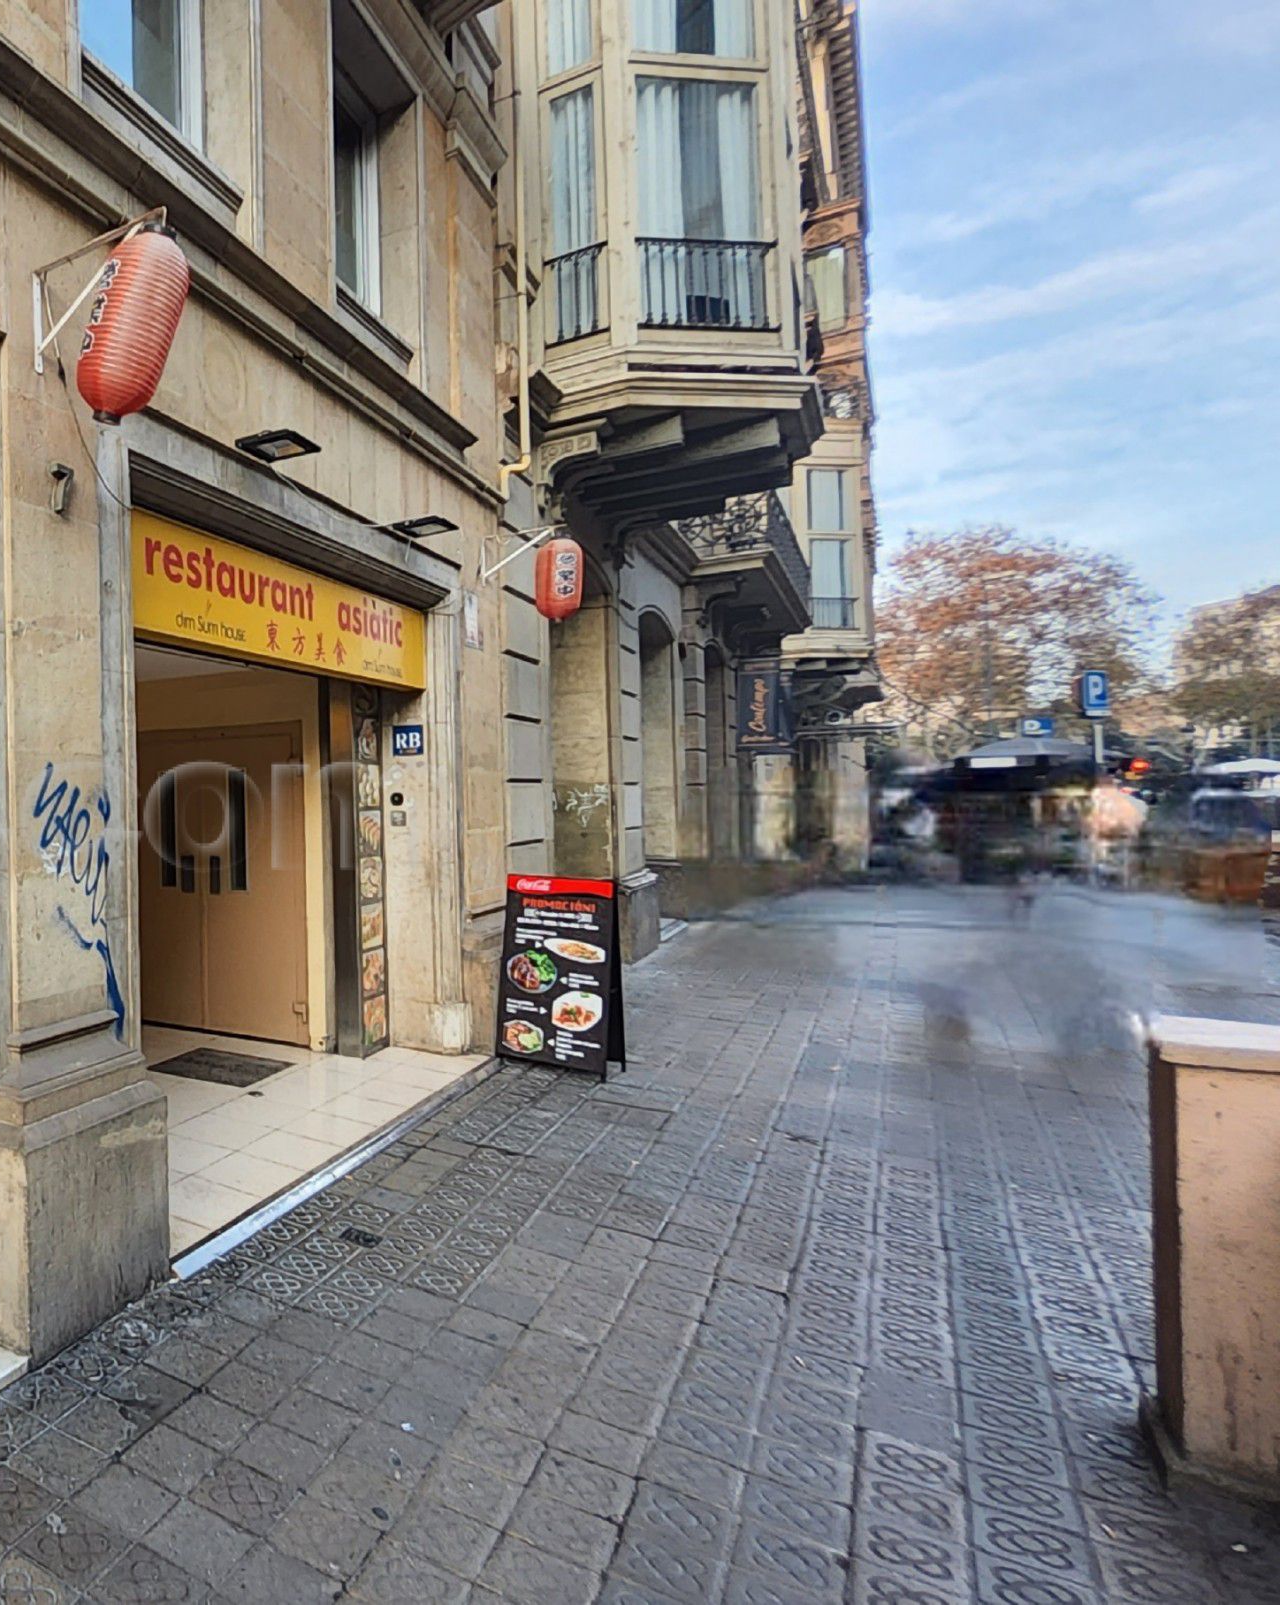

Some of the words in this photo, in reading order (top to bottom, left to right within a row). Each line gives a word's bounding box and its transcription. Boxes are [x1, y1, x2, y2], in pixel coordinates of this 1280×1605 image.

[144, 536, 314, 621] restaurant
[337, 596, 403, 648] asiàtic
[266, 619, 347, 667] 東方美食
[1088, 674, 1104, 704] P
[396, 732, 421, 749] RB
